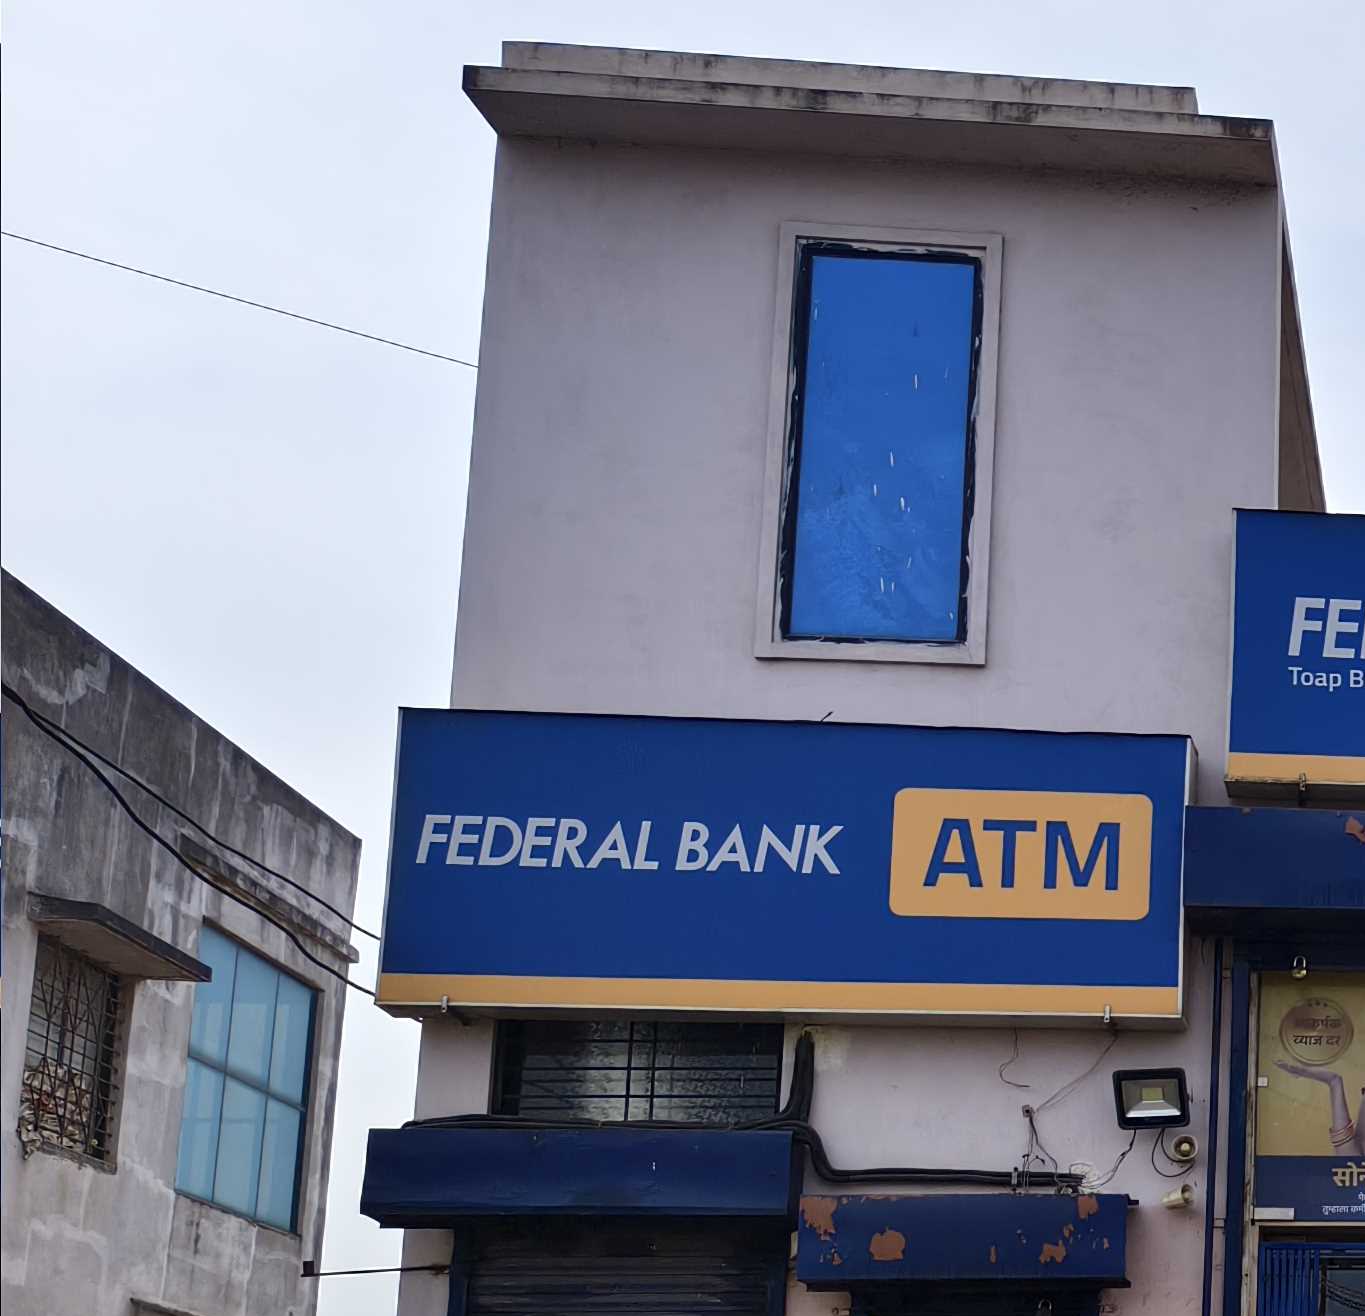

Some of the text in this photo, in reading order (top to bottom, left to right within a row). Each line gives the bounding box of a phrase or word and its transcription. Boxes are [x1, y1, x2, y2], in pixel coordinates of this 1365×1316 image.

[1288, 666, 1342, 692] Toap
[415, 814, 1121, 891] FEDERAL BANK ATM
